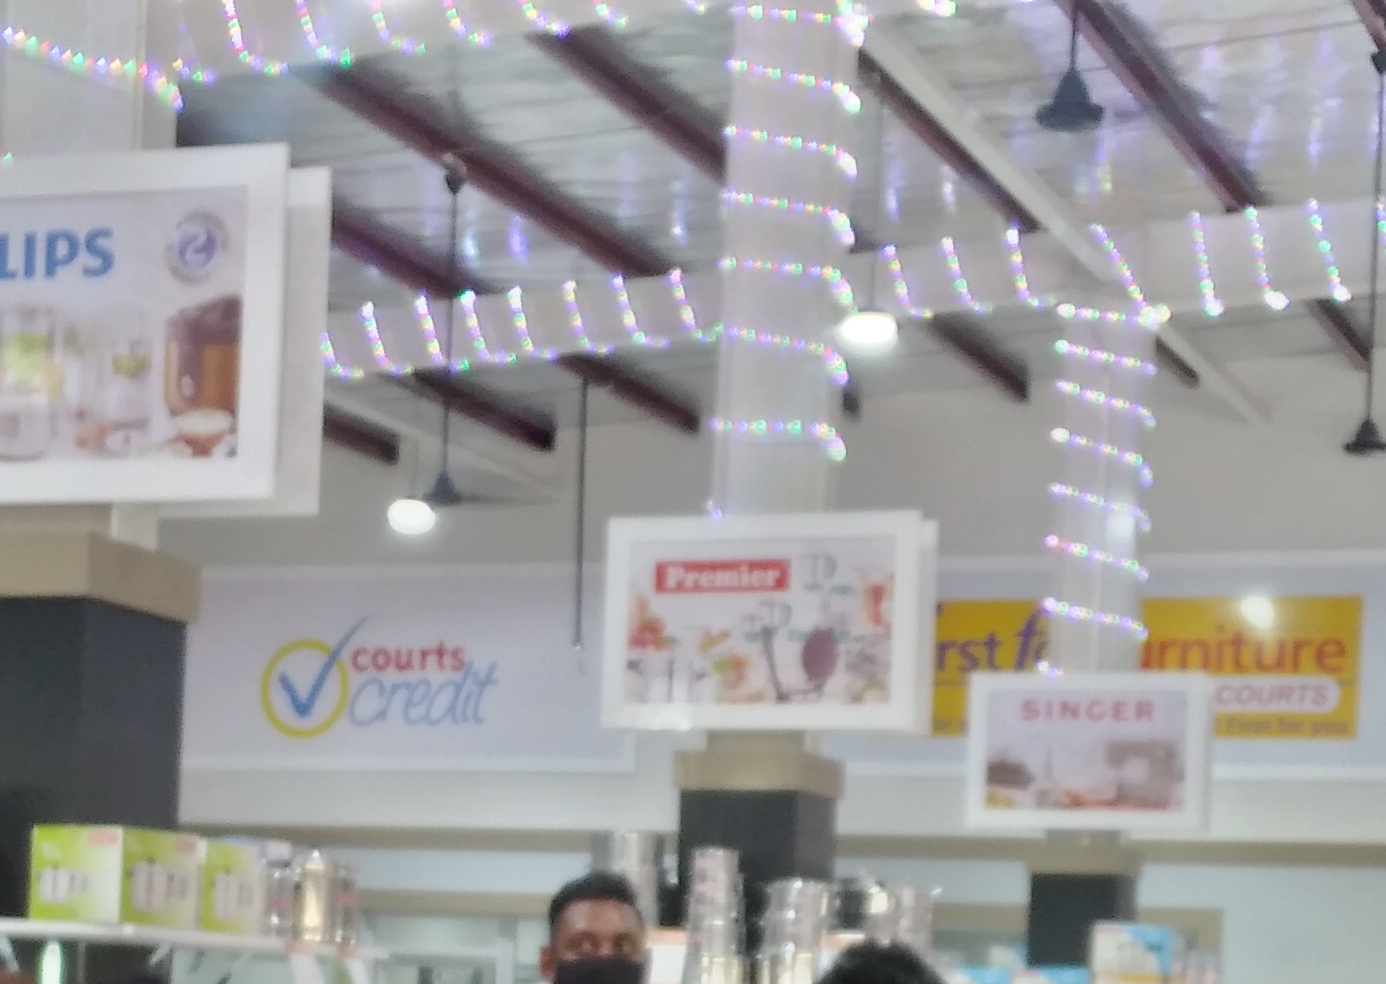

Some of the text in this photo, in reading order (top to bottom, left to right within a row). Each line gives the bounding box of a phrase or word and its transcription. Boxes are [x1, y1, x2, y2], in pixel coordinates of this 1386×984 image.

[666, 564, 780, 590] Premier
[351, 641, 465, 673] courts
[935, 631, 1000, 673] rst
[348, 660, 498, 727] credit
[1214, 683, 1330, 707] COURTS
[1021, 698, 1155, 723] SINGER
